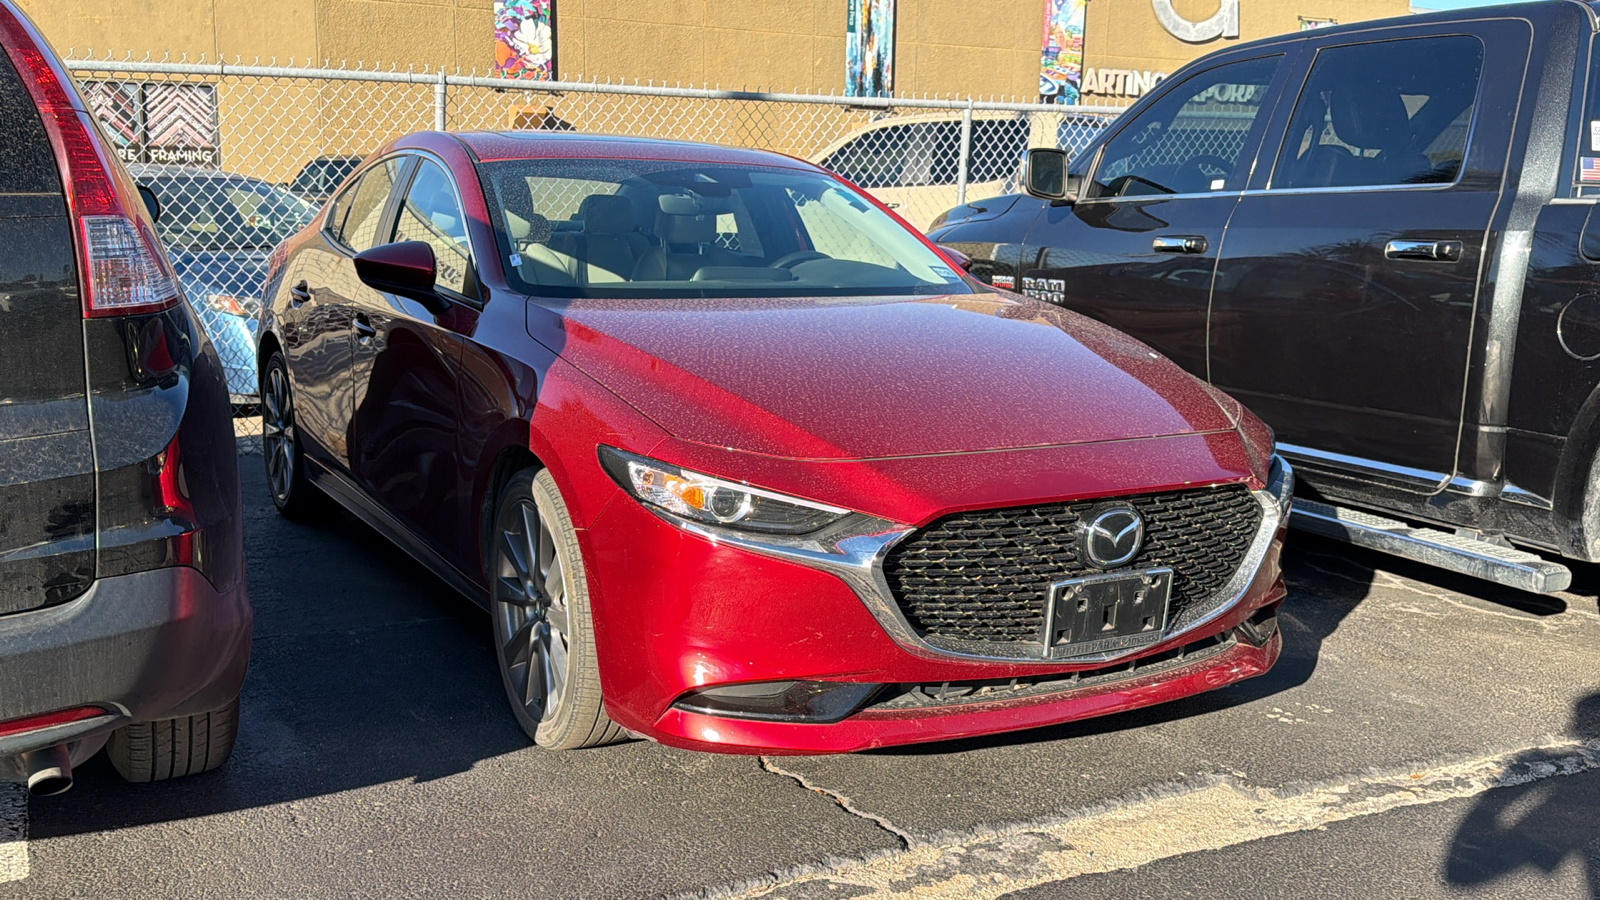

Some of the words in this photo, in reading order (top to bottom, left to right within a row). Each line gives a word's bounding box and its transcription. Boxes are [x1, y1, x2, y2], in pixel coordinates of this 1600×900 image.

[151, 149, 213, 162] FRAMING
[1022, 277, 1065, 293] RAM
[1022, 289, 1065, 303] 1500
